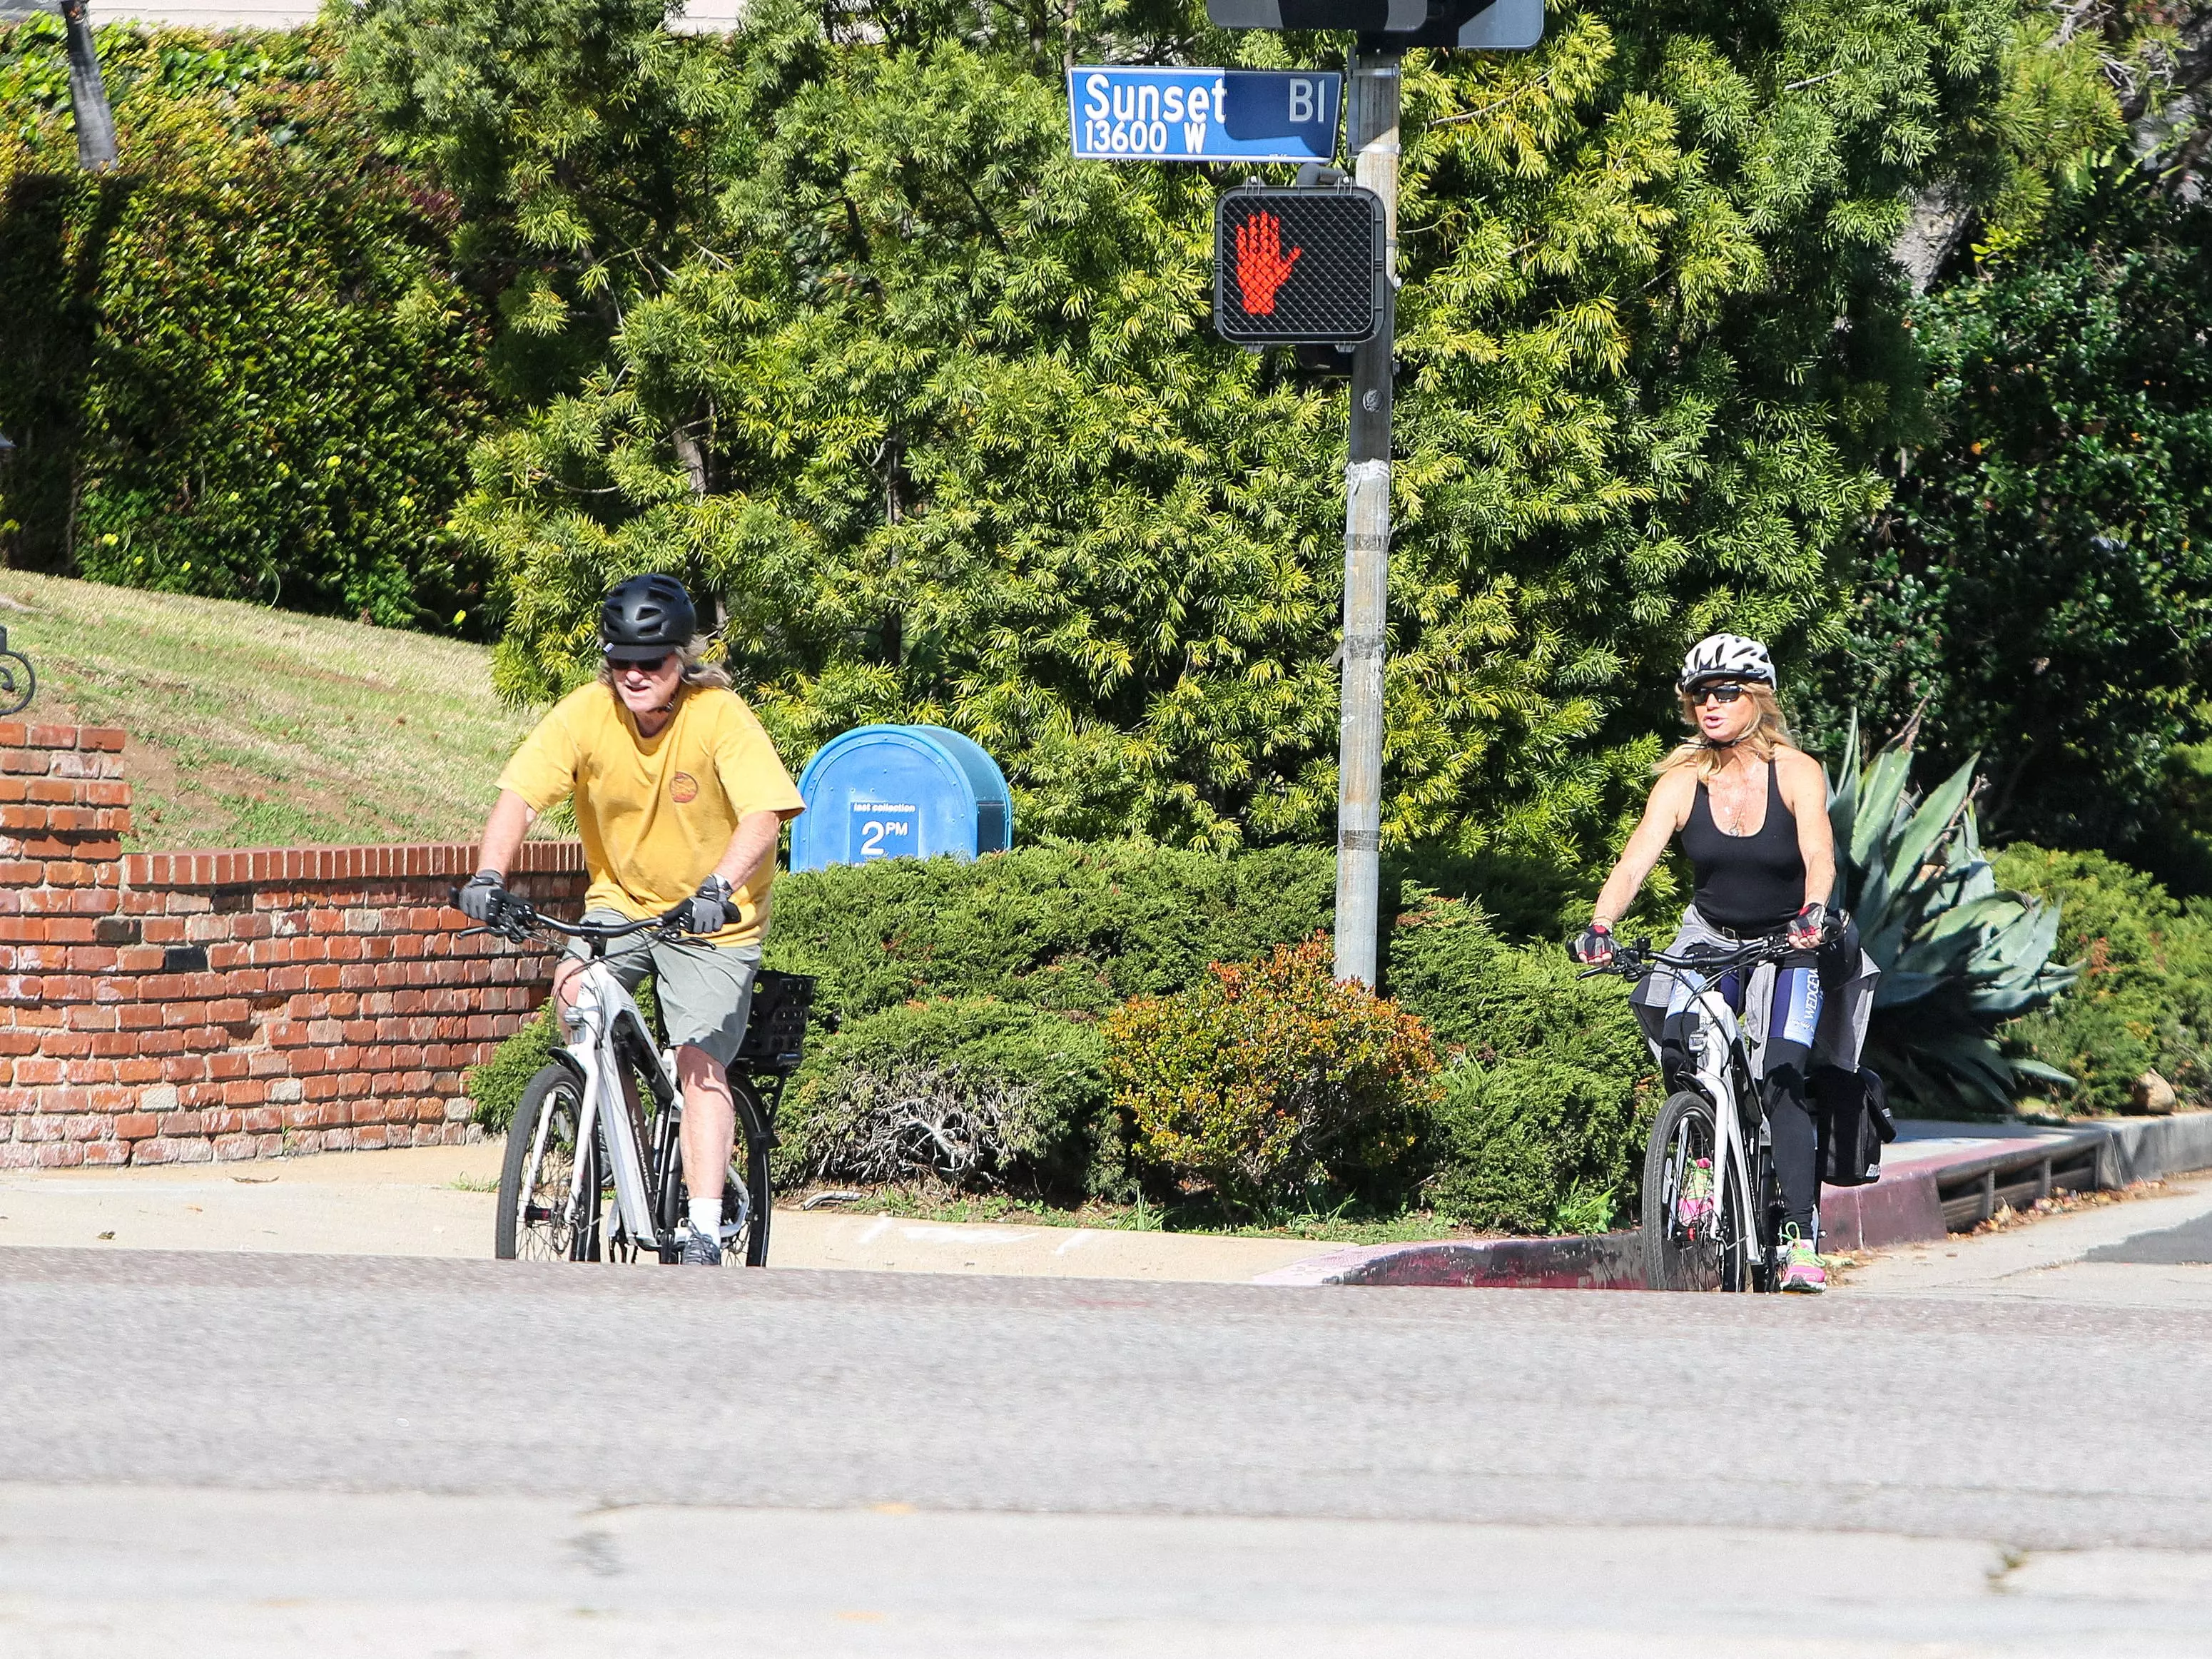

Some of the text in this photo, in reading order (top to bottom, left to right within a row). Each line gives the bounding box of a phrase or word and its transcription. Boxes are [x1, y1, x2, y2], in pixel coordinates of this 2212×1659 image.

[1084, 73, 1324, 123] Sunset Bl
[1085, 119, 1207, 154] 13600 W
[872, 803, 915, 813] collection
